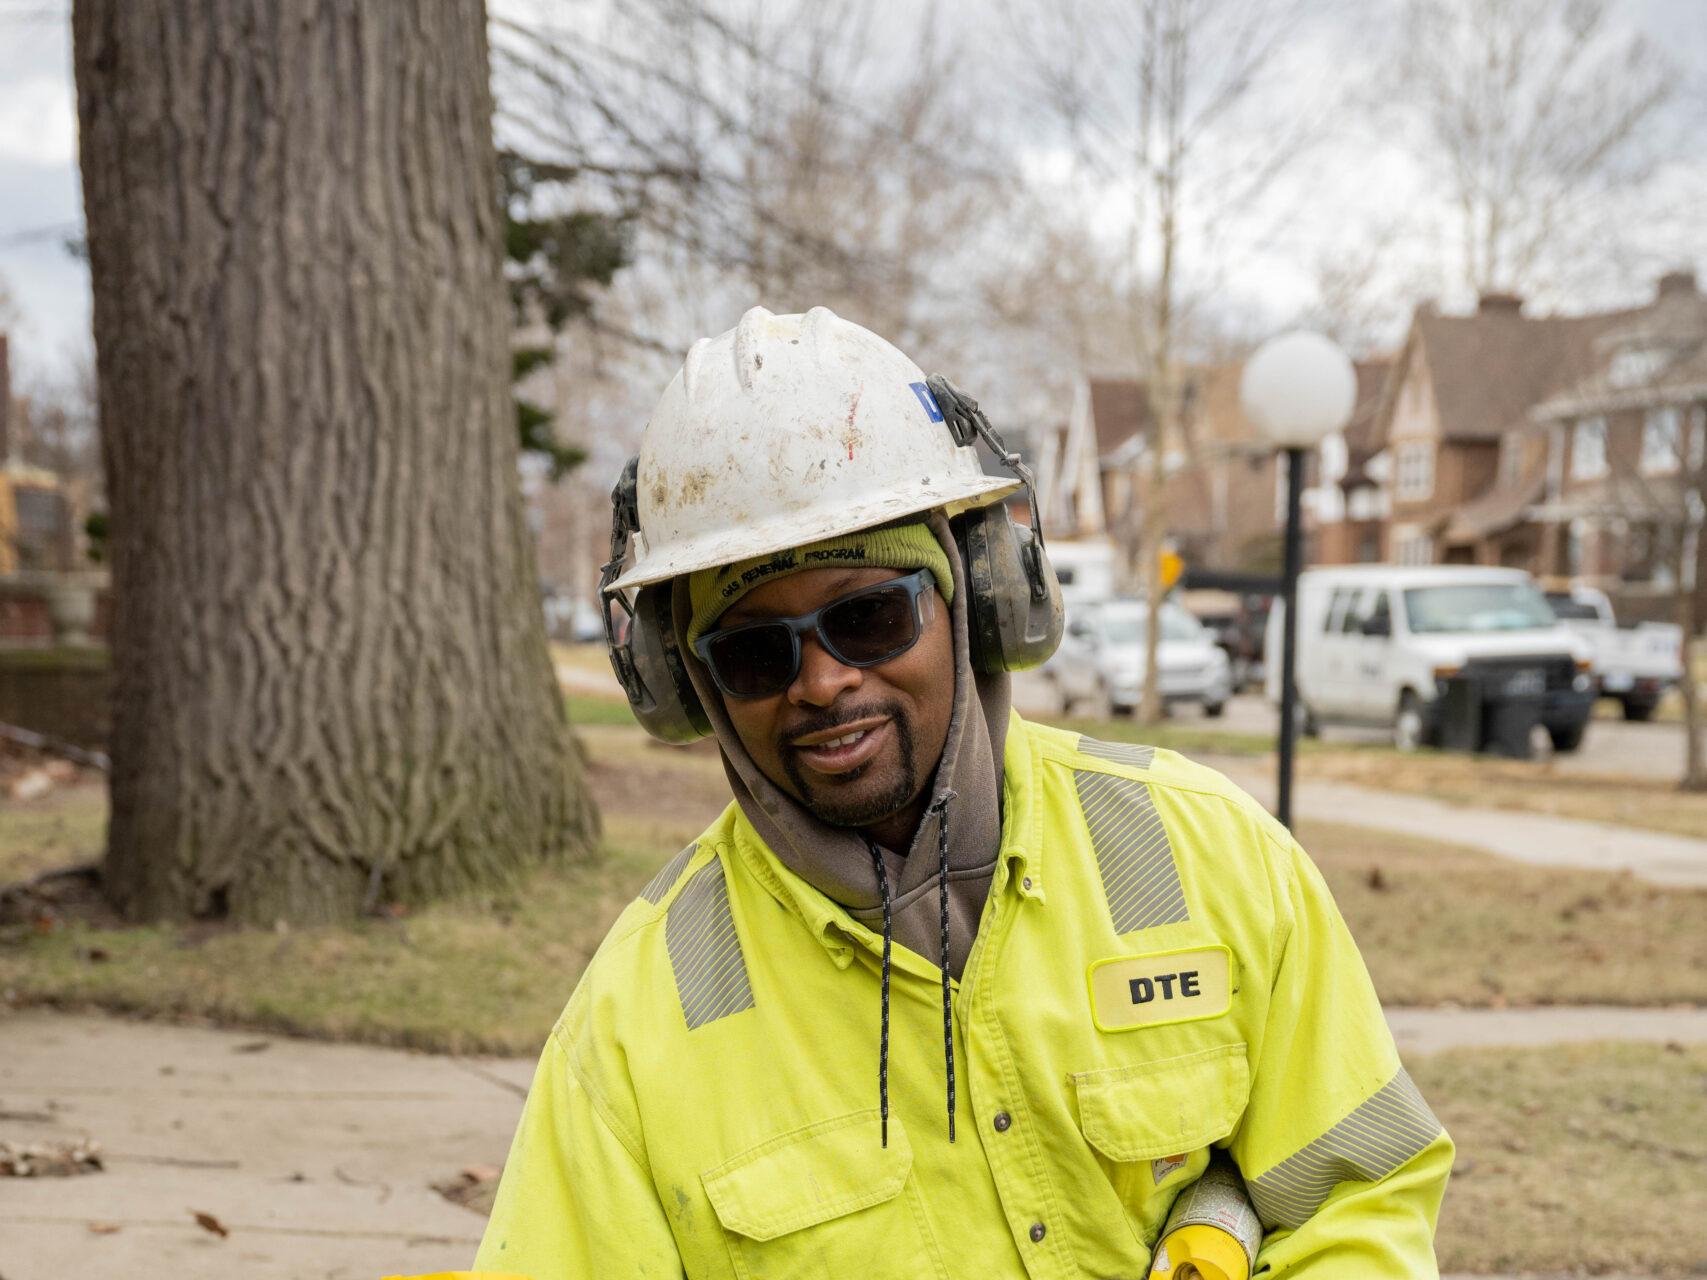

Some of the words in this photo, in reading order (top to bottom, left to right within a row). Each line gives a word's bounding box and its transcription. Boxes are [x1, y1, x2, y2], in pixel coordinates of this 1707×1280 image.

[722, 581, 741, 598] GAS
[804, 548, 866, 562] PROGRAM
[1128, 970, 1201, 1005] DTE
